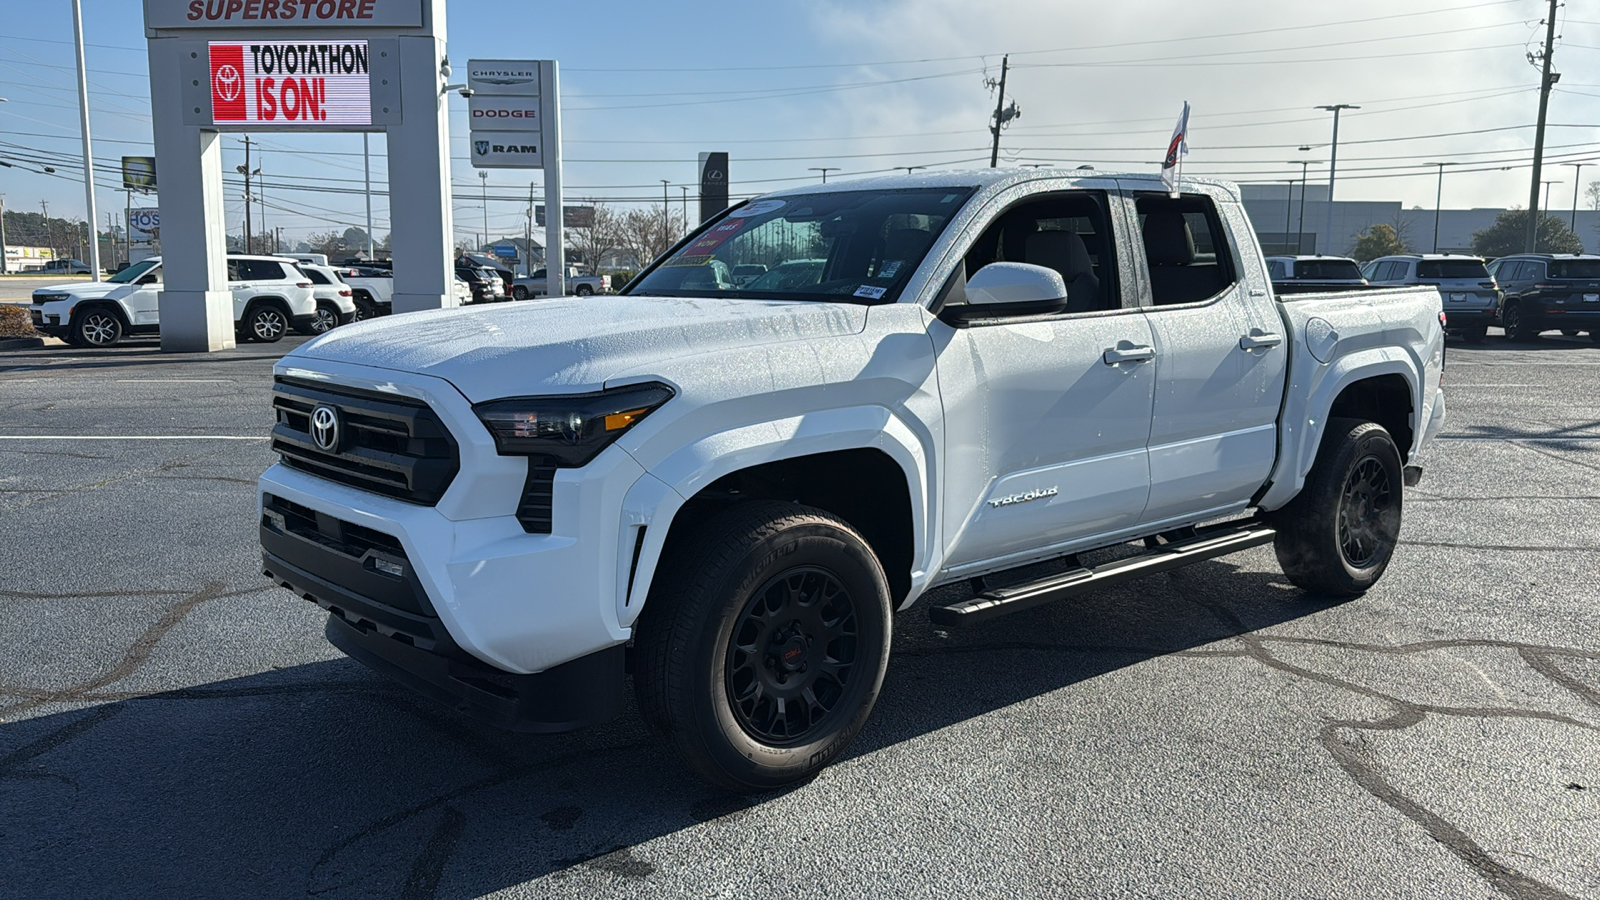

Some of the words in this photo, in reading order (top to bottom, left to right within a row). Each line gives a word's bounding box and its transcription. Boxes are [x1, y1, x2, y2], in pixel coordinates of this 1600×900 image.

[187, 0, 376, 20] SUPERSTORE
[250, 44, 368, 74] TOYOTATHON
[255, 77, 277, 120] IS
[280, 76, 327, 121] ON!
[472, 109, 536, 118] DODGE
[492, 144, 537, 153] RAM
[740, 541, 797, 590] MICHELIN
